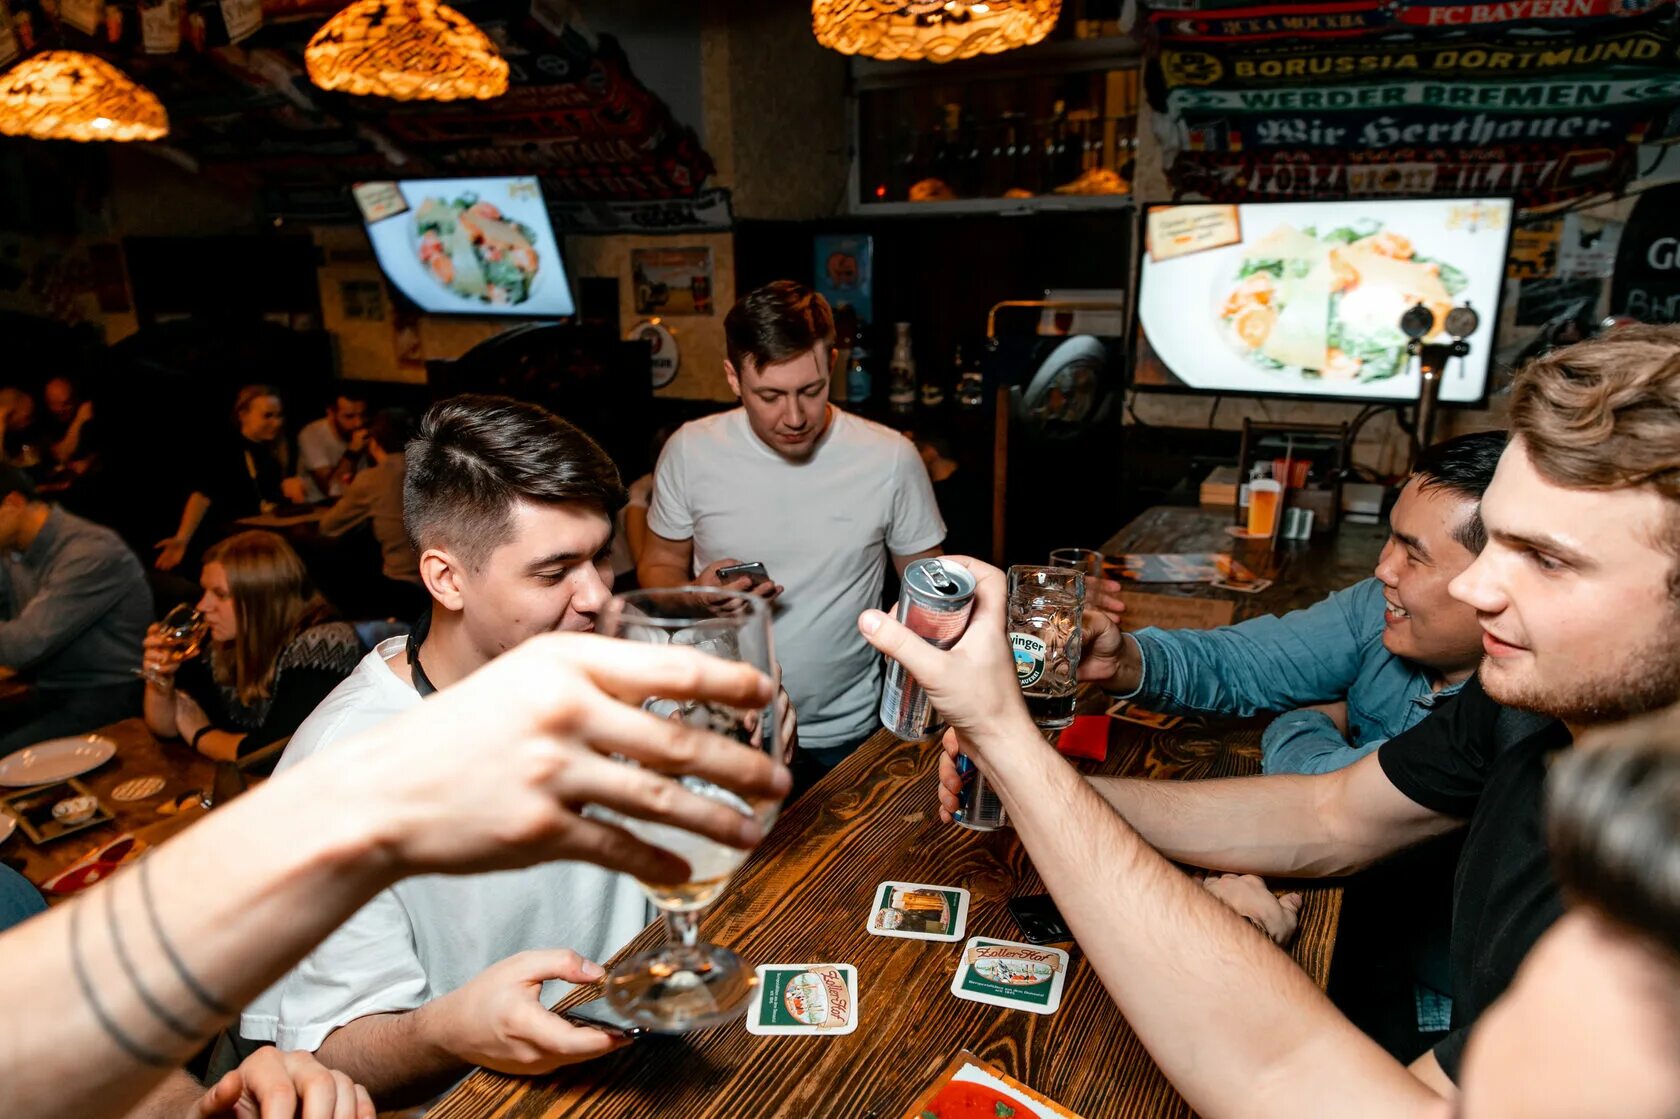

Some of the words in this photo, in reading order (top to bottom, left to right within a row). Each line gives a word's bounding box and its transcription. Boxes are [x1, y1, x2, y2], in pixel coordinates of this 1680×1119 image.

[1427, 4, 1467, 26] FC
[1470, 0, 1596, 24] BAYERN
[1233, 53, 1418, 78] BORUSSIA
[1432, 37, 1664, 70] DORTMUND
[1240, 87, 1406, 108] WERDER
[1422, 84, 1611, 106] BREMEN
[1020, 670, 1040, 686] AUEREI
